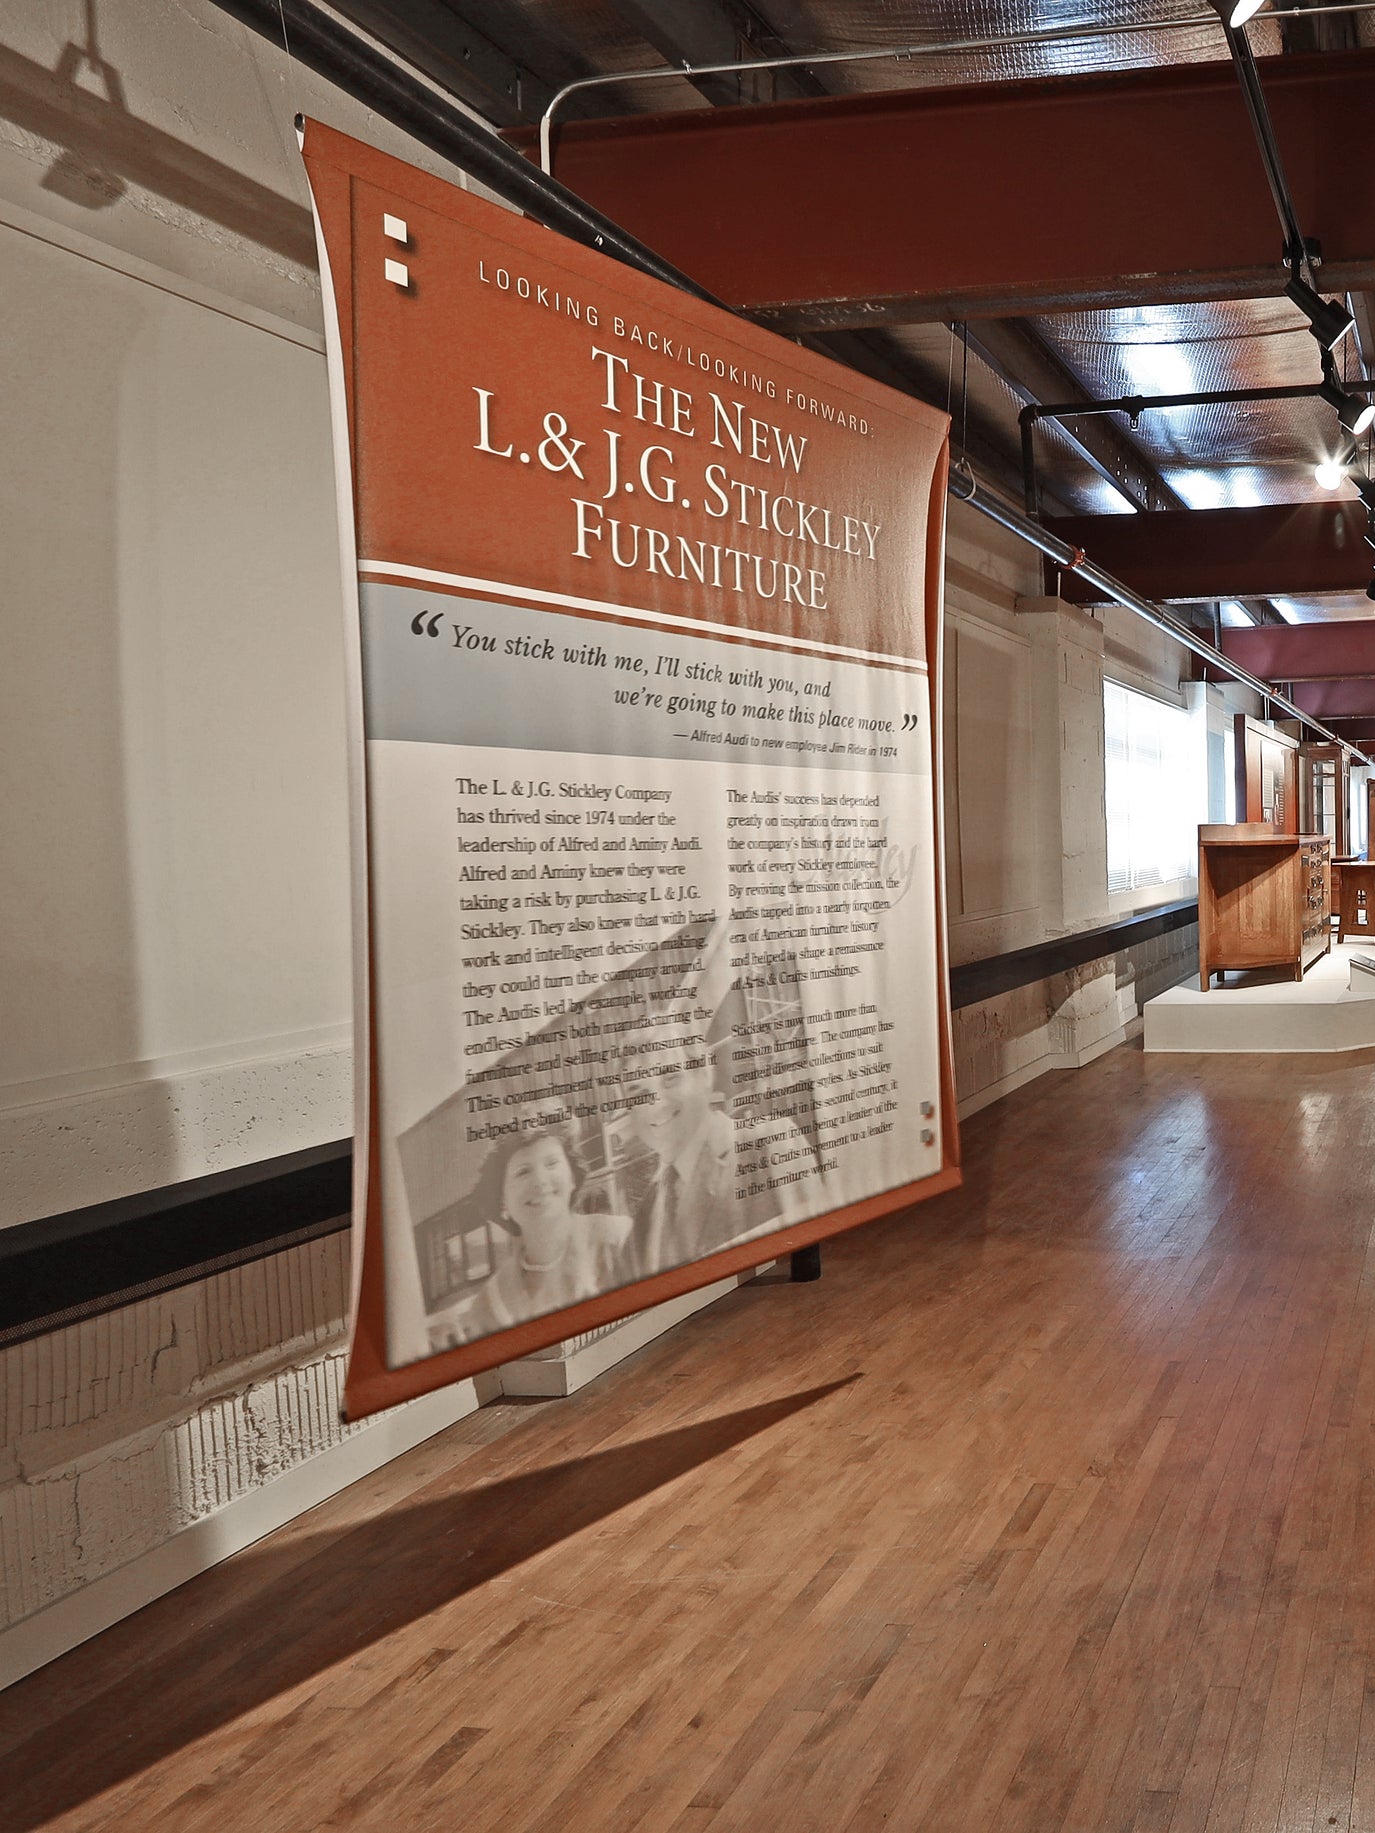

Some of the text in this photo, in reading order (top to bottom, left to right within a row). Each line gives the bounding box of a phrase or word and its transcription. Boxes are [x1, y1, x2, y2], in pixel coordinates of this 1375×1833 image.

[479, 260, 875, 439] LOOKING BACK/LOOKING FORWARD:
[602, 429, 690, 509] J.G.
[451, 623, 497, 652] You
[503, 635, 555, 661] stick
[562, 644, 608, 668] with
[614, 655, 649, 677] me,
[654, 655, 680, 678] I’ll
[684, 662, 723, 683] stick
[728, 670, 763, 689] with
[766, 676, 799, 697] you,
[803, 681, 832, 698] and
[613, 685, 663, 709] we’re
[666, 692, 718, 718] going
[721, 698, 737, 716] to
[742, 701, 785, 721] make
[788, 705, 815, 725] this
[817, 710, 855, 729] place
[857, 718, 896, 733] move.
[690, 729, 723, 745] Alfred
[723, 732, 749, 747] Audi
[750, 736, 760, 748] to
[761, 739, 784, 750] new
[784, 740, 828, 754] employee
[828, 741, 846, 754] Jim
[868, 745, 877, 756] in
[879, 746, 898, 758] 1974
[455, 777, 673, 803] The L. & J.G. Stickley Company
[726, 789, 748, 803] The
[784, 794, 820, 805] success
[820, 793, 838, 806] has
[839, 794, 880, 808] depended
[456, 807, 677, 826] has thrived since 1974 under the
[457, 836, 536, 855] leadership
[540, 836, 556, 852] of
[557, 836, 599, 852] Alfred
[602, 837, 626, 851] and
[670, 837, 703, 851] Audi.
[458, 865, 507, 881] Alfred
[511, 864, 537, 880] and
[588, 863, 625, 878] knew
[627, 862, 656, 879] they
[656, 865, 687, 876] were
[460, 885, 702, 912] taking a risk by purchasing L. & J.G.
[460, 909, 716, 940] Stickley. They also knew that with hard
[461, 951, 501, 968] work
[504, 948, 532, 965] and
[534, 944, 604, 962] intelligent
[606, 939, 659, 955] decision
[462, 982, 496, 998] they
[500, 975, 541, 994] could
[543, 976, 573, 989] turn
[576, 970, 599, 985] the
[601, 967, 659, 982] company
[463, 1010, 494, 1026] The
[497, 1006, 541, 1022] Audis
[543, 999, 565, 1016] led
[569, 998, 586, 1015] by
[648, 985, 698, 1000] working
[464, 1007, 714, 1055] endless hours both manufacturing the
[465, 1063, 532, 1085] furniture
[535, 1054, 561, 1072] and
[563, 1049, 609, 1066] selling
[610, 1045, 621, 1059] it
[622, 1046, 637, 1057] to
[464, 1053, 719, 1113] This commitment was infectious and it
[466, 1117, 519, 1142] helped
[522, 1105, 573, 1130] rebuild
[574, 1102, 598, 1118] the
